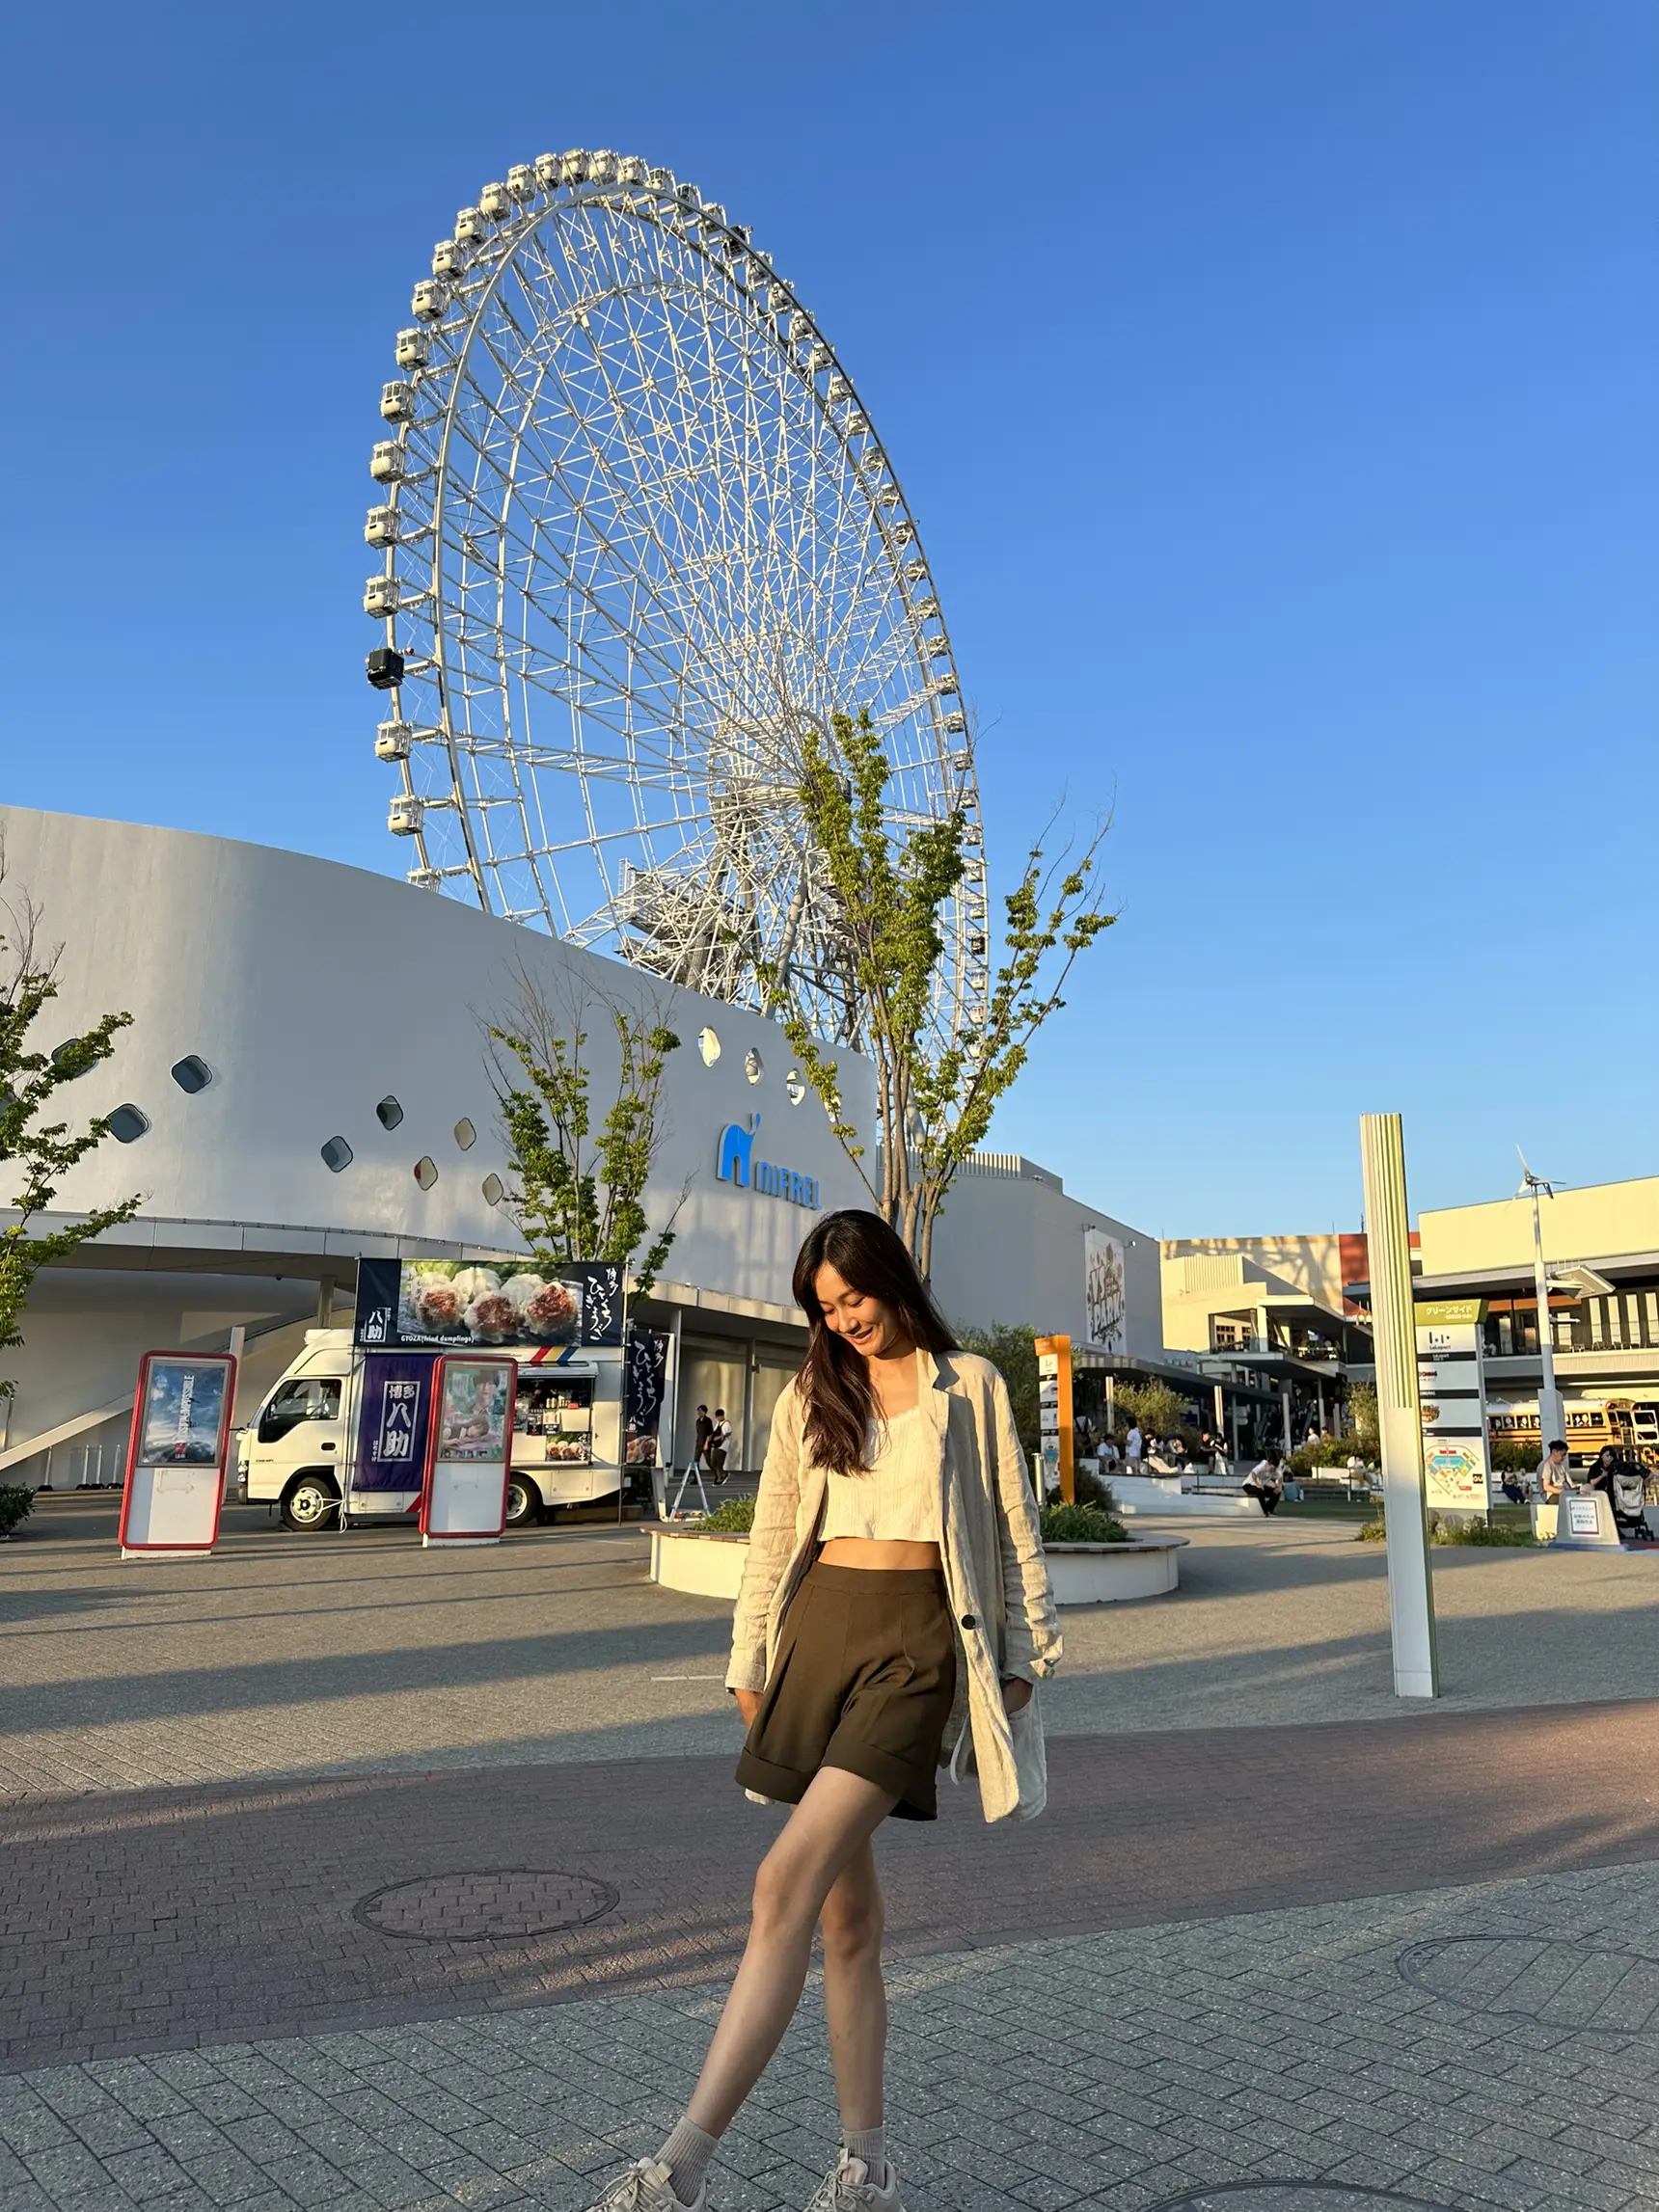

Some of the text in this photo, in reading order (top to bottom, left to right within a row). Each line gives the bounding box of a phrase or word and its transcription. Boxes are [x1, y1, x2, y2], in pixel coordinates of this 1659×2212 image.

[1426, 1305, 1473, 1315] グリーンサイド
[367, 1309, 384, 1340] 八助
[388, 1385, 416, 1399] 博多
[383, 1402, 412, 1457] 八助
